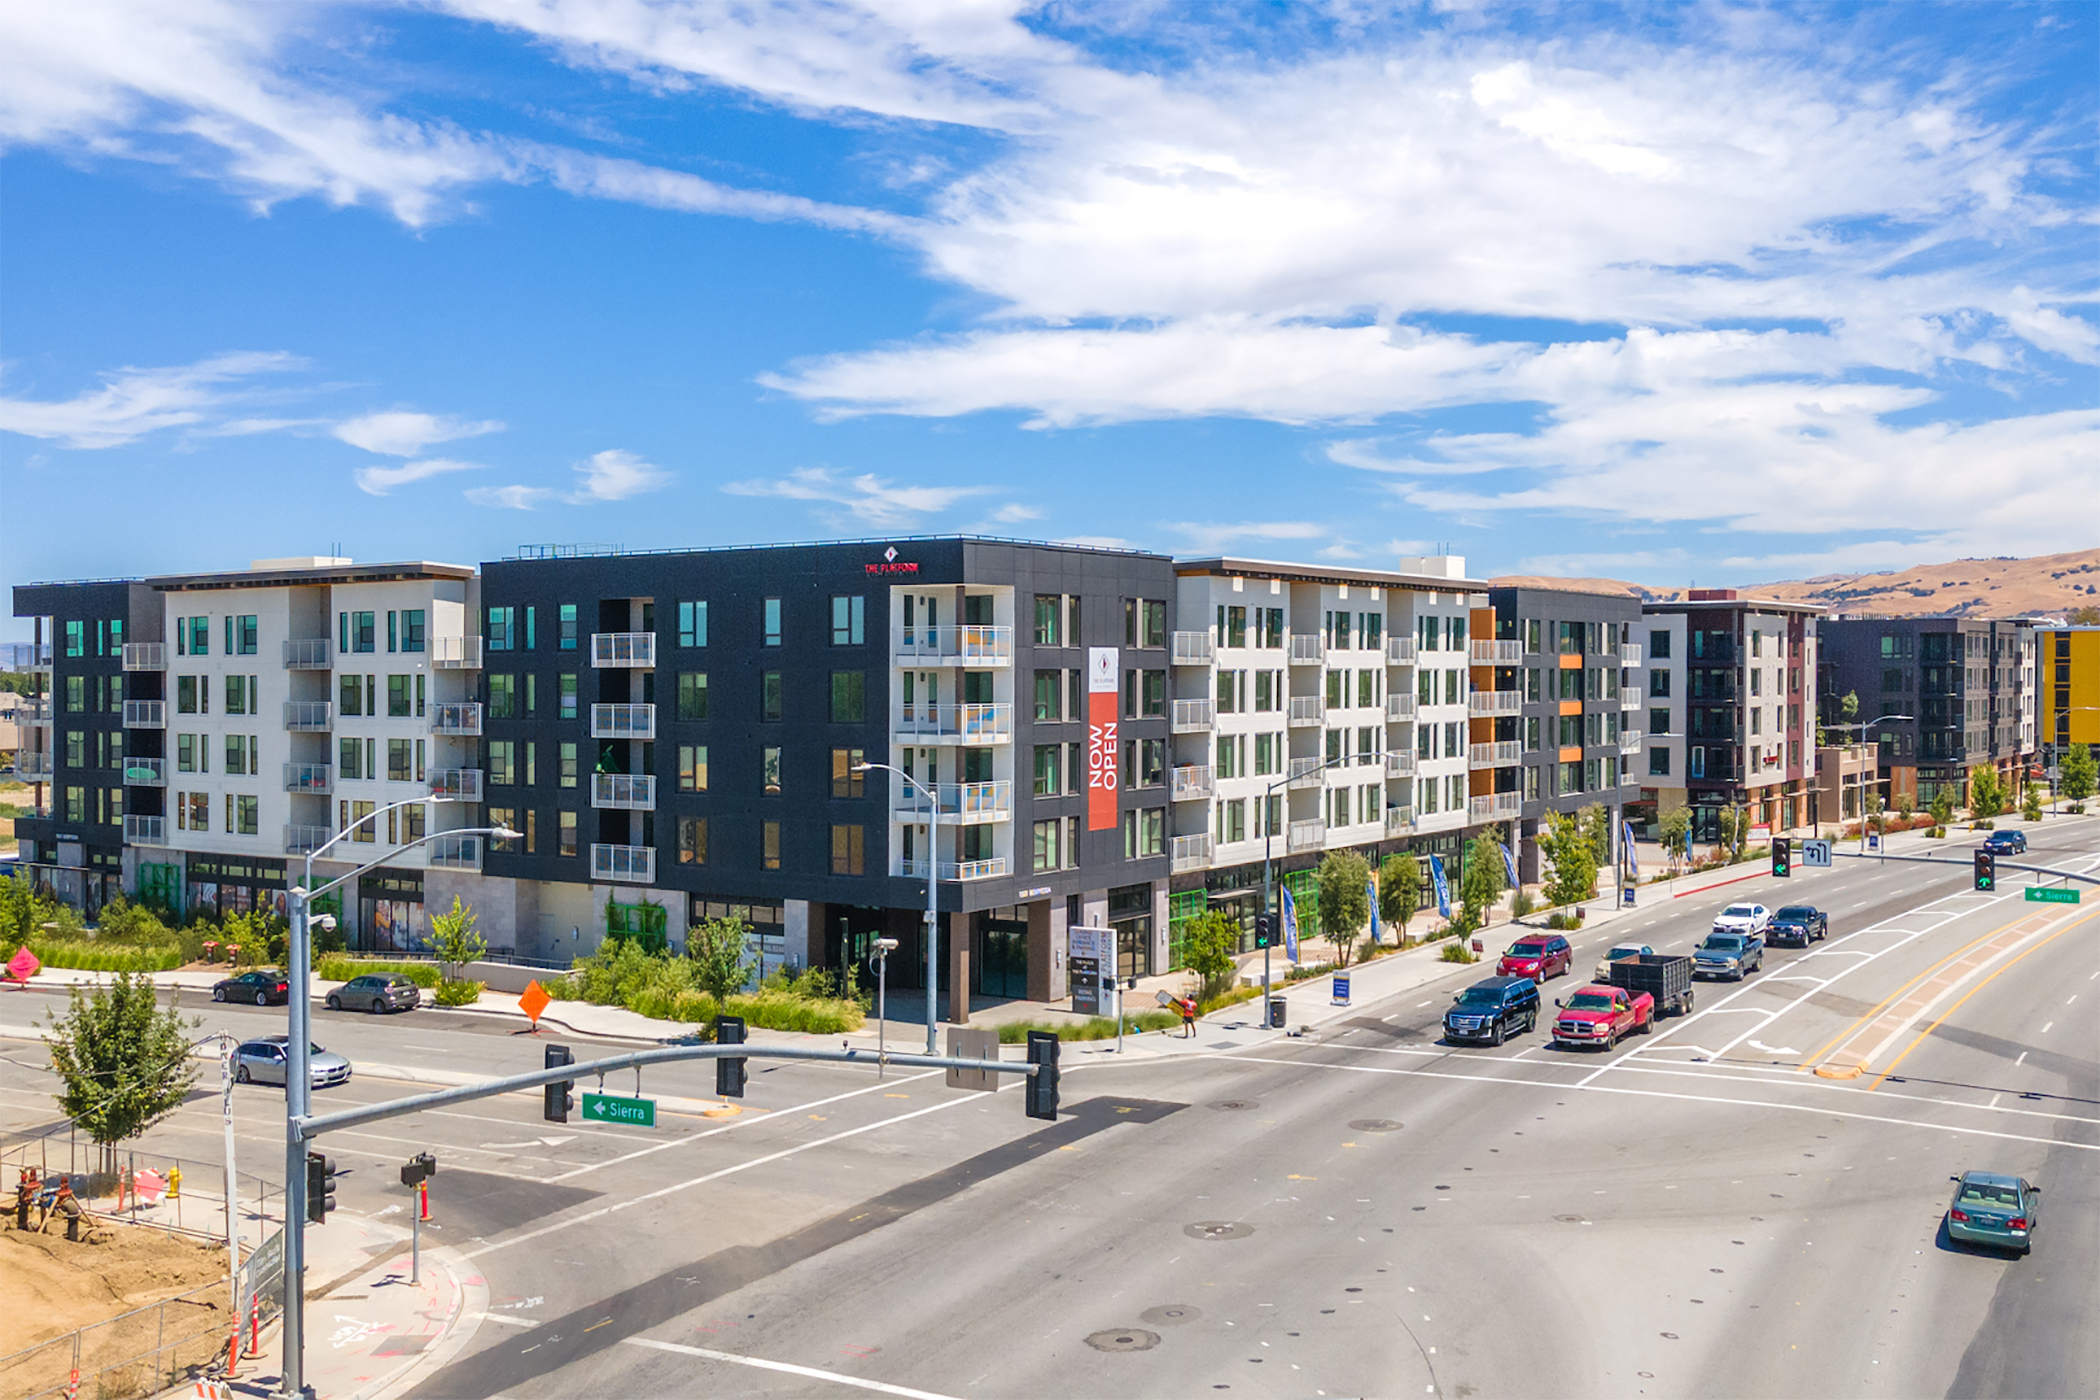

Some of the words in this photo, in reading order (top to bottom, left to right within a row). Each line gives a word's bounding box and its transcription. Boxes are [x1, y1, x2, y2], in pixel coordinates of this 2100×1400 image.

[865, 564, 878, 573] THE
[881, 563, 918, 572] PLATFORM
[1089, 725, 1103, 787] NOW
[1103, 723, 1117, 790] OPEN
[2045, 891, 2073, 901] Sierra
[610, 1102, 644, 1119] Sierra
